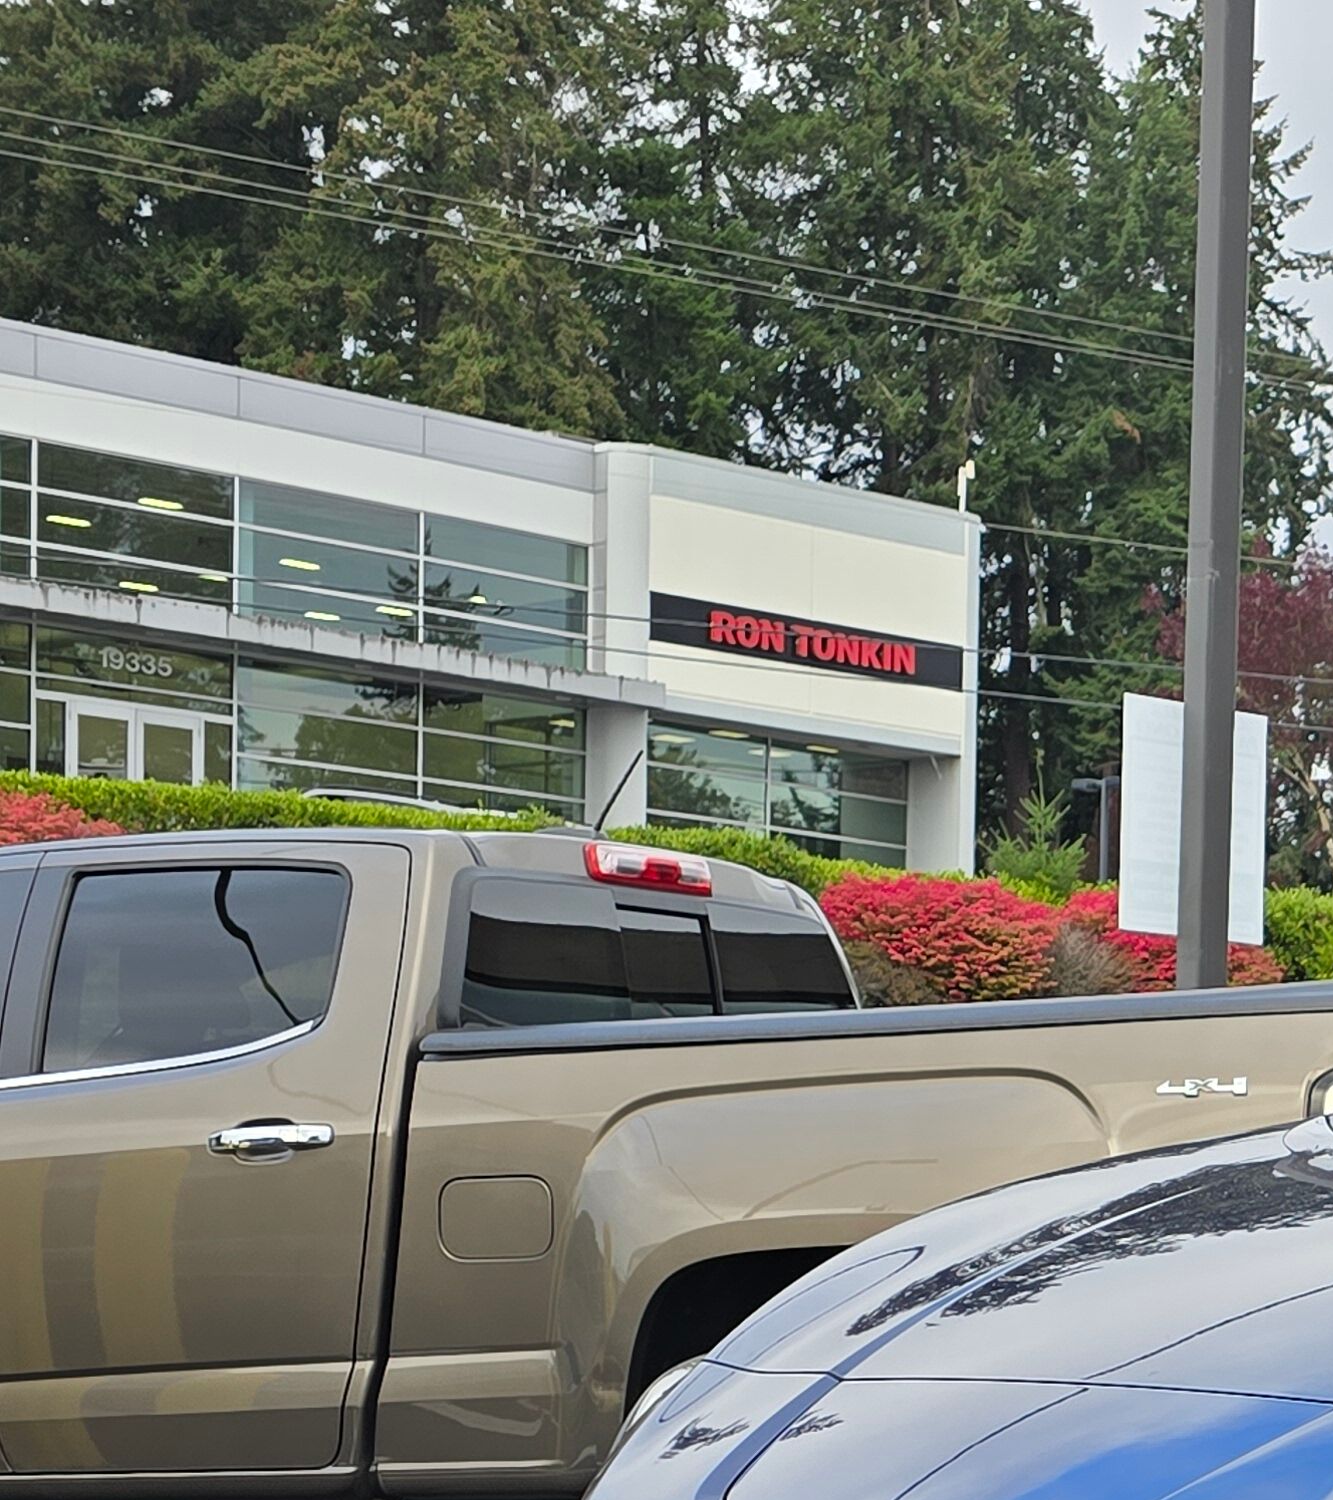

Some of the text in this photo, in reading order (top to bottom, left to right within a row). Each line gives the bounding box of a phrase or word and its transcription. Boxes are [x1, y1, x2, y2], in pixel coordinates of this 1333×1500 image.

[98, 646, 173, 677] 19335
[708, 610, 917, 675] RON TONKIN
